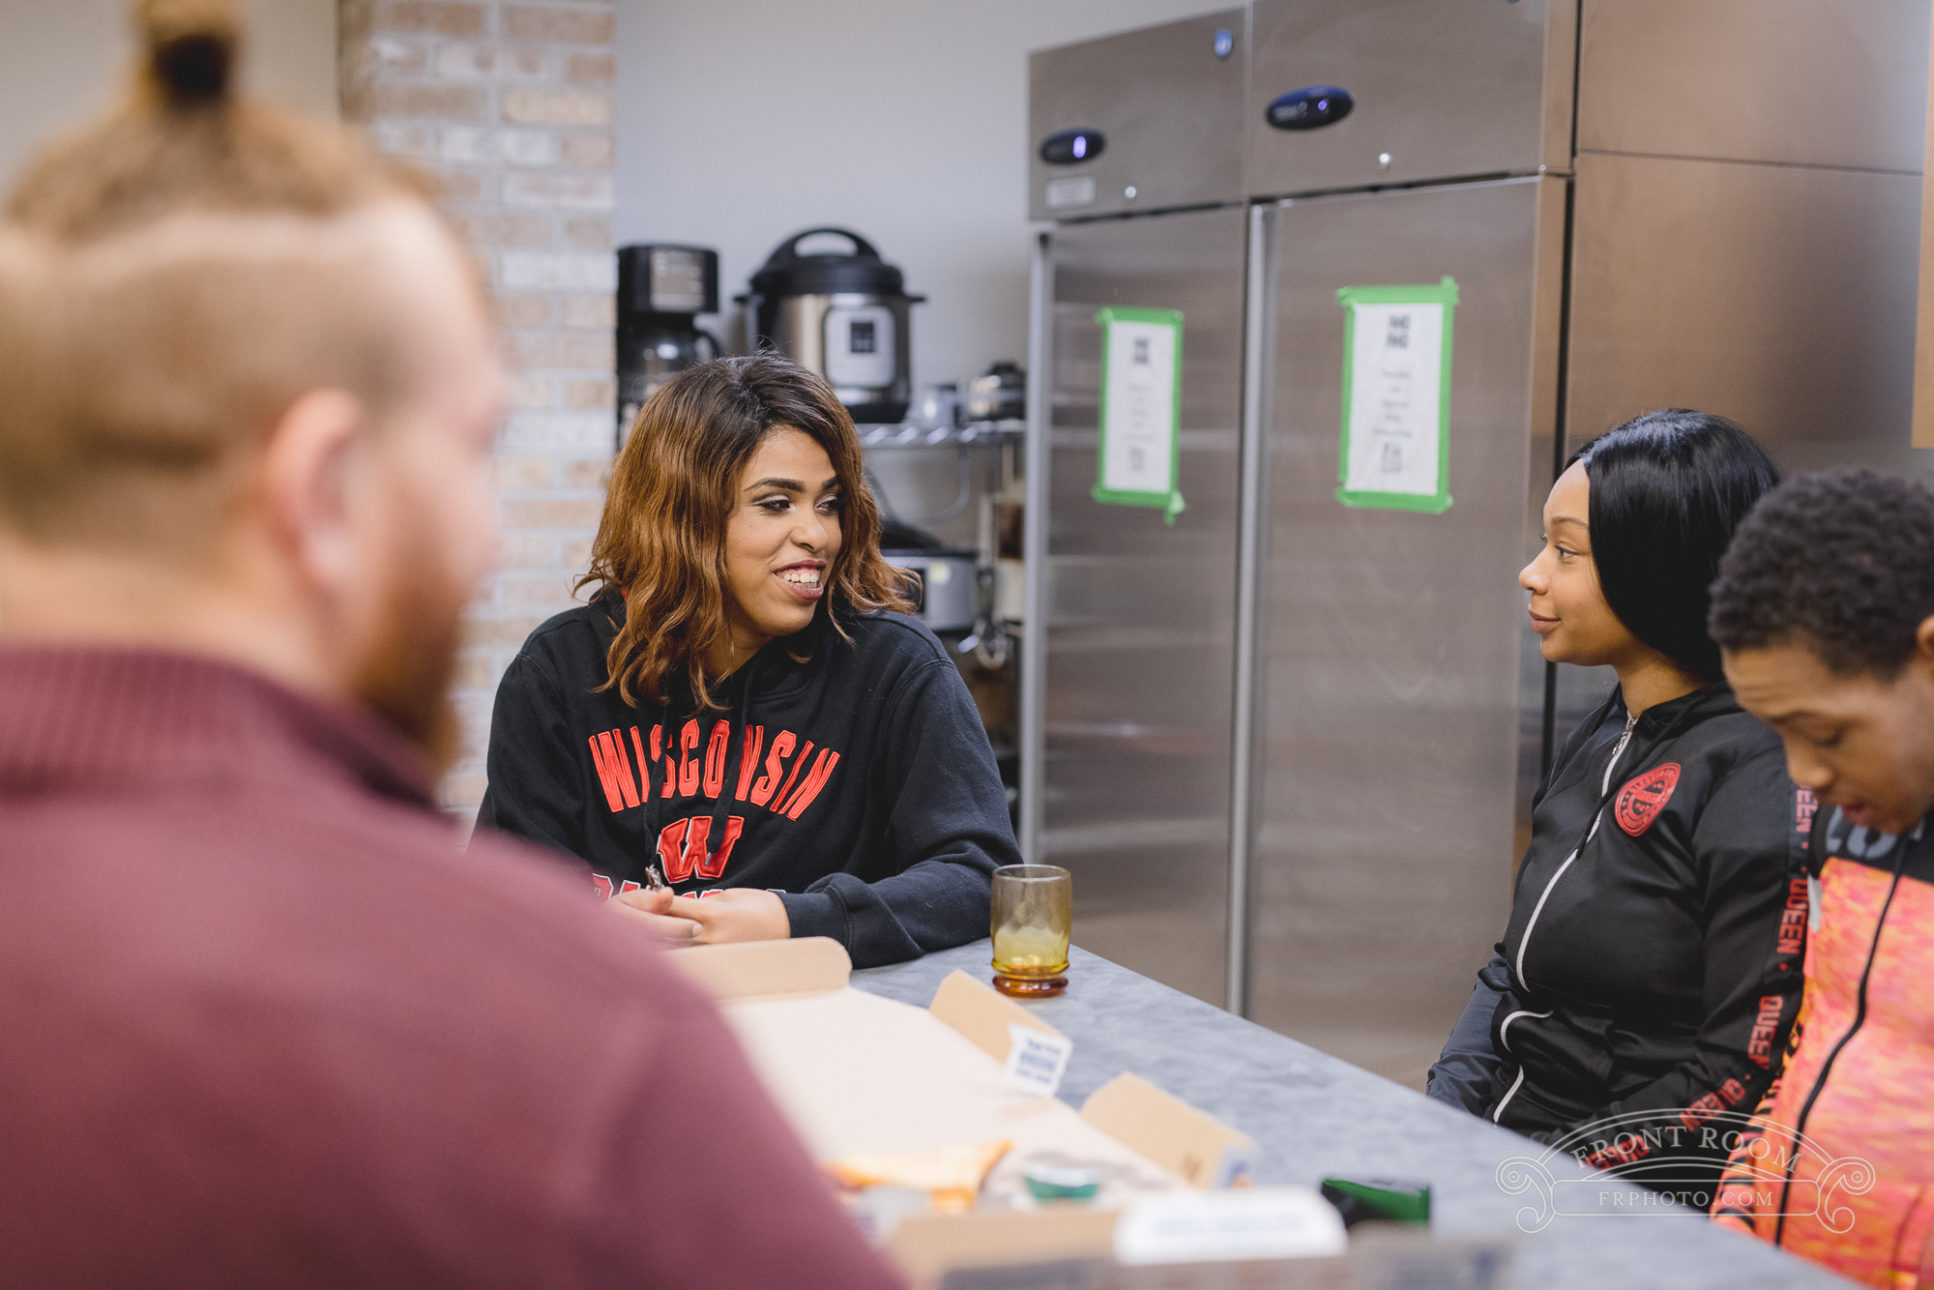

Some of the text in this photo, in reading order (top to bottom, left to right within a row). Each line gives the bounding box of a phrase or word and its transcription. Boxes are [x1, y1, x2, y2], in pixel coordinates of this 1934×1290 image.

[588, 718, 841, 821] WISCONSIN
[656, 815, 745, 884] W
[1776, 878, 1809, 955] QUEEN
